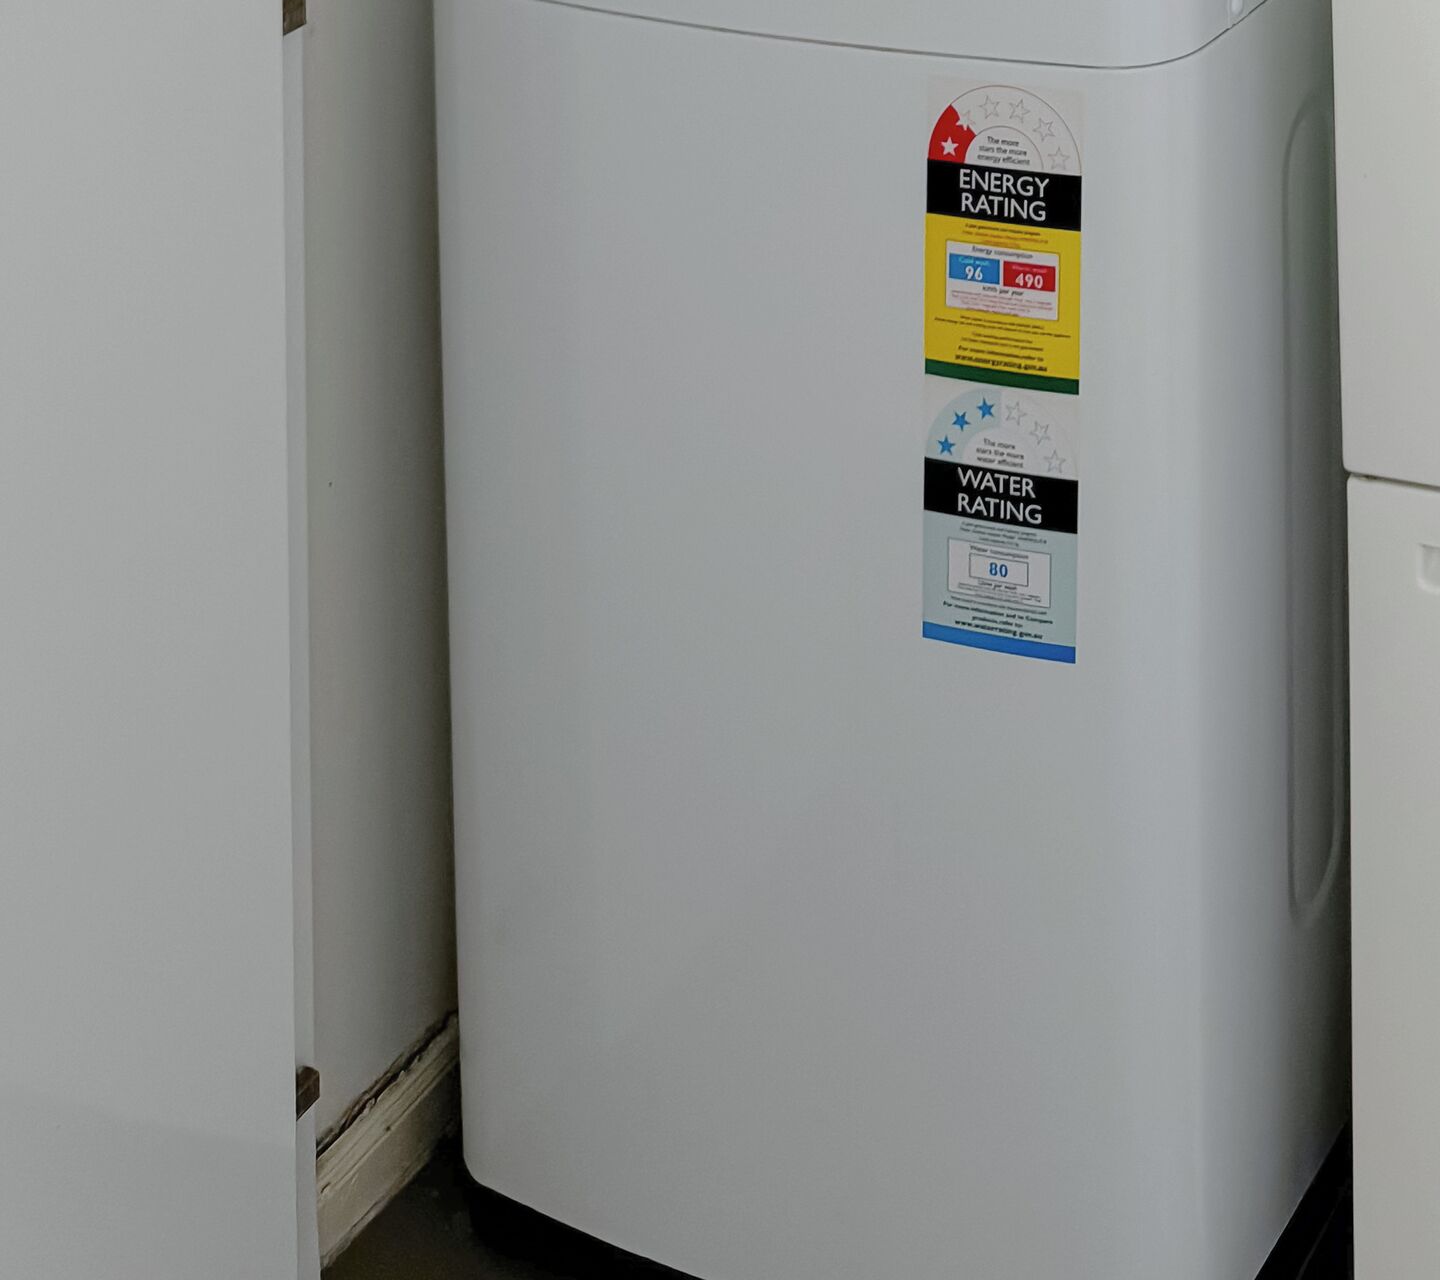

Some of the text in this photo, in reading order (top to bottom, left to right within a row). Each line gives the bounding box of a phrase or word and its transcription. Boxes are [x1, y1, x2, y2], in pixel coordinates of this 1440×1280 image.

[959, 168, 1050, 198] ENERGY
[960, 192, 1046, 222] RATING
[965, 266, 983, 280] 96
[1016, 273, 1043, 288] 490
[957, 466, 1036, 498] WATER
[957, 493, 1042, 524] RATING
[989, 562, 1008, 578] 80
